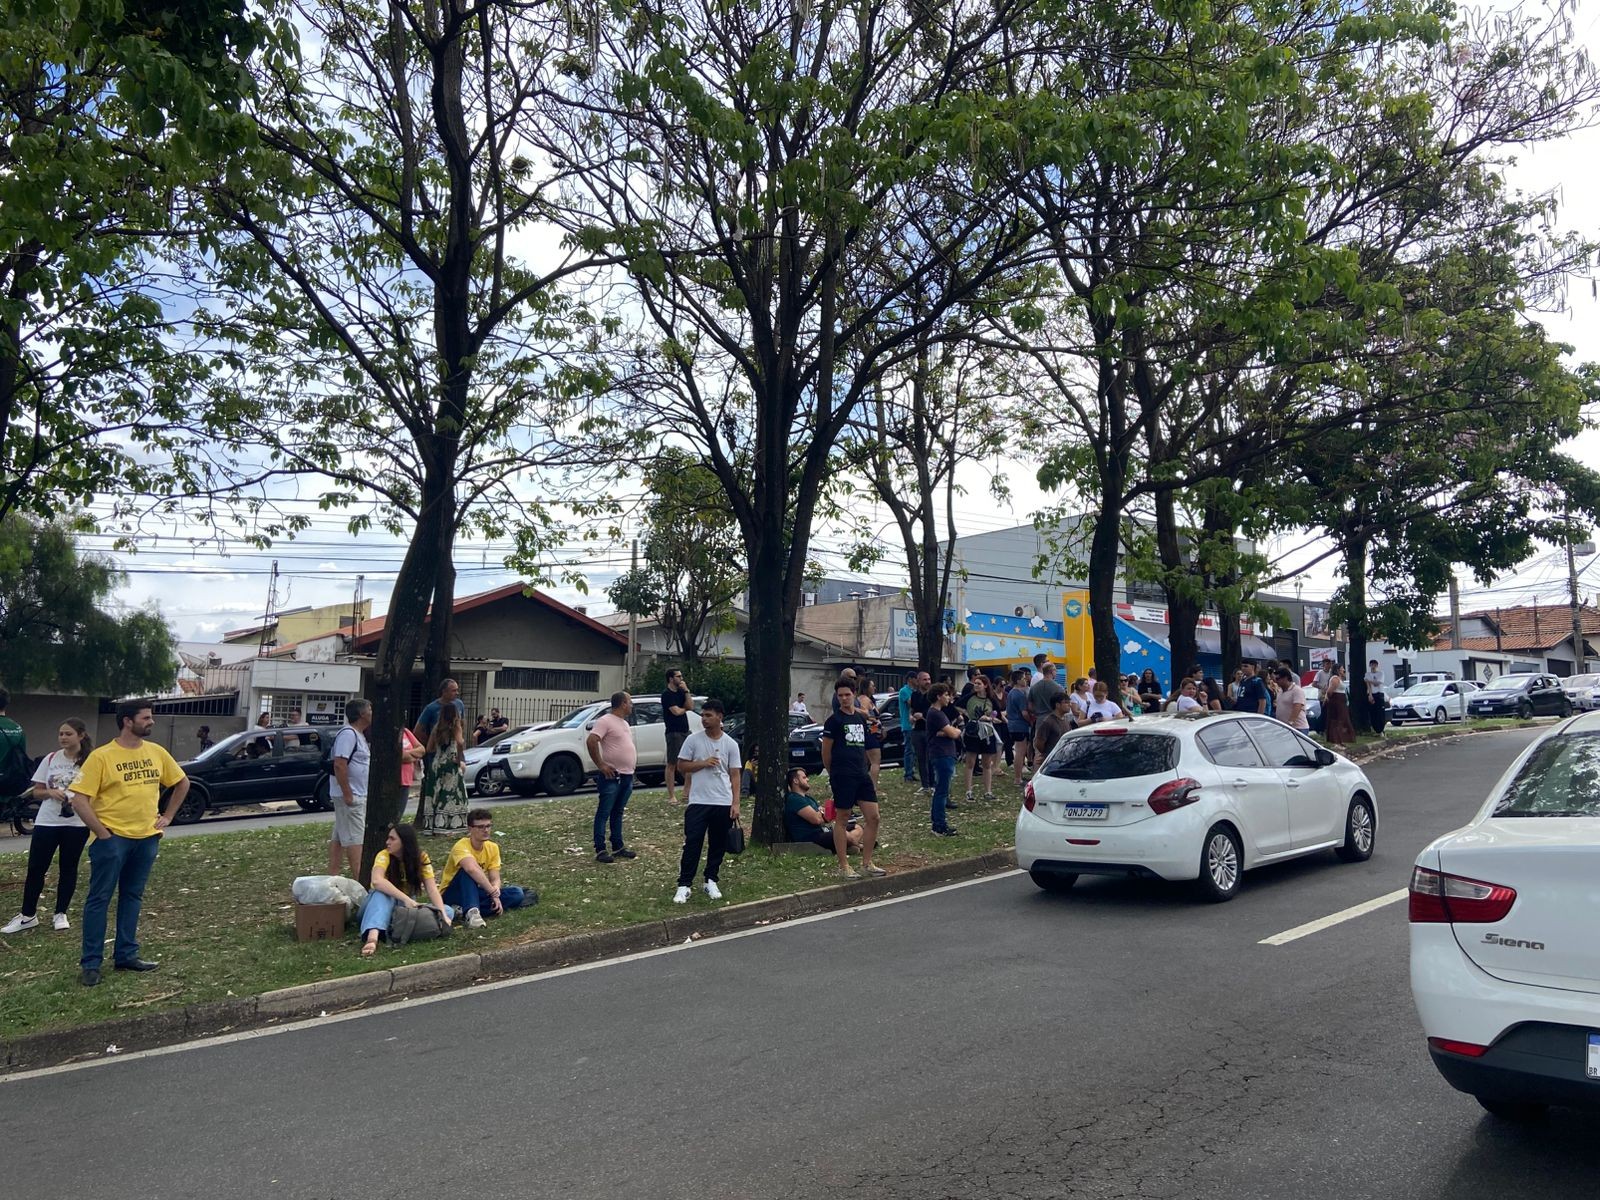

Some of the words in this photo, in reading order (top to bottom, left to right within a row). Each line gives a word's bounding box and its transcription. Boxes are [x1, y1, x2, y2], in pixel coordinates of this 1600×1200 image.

[116, 758, 153, 772] ORGULHO
[123, 769, 160, 782] OBJETIVO
[1480, 933, 1545, 950] Siena
[1588, 1066, 1598, 1076] BR
